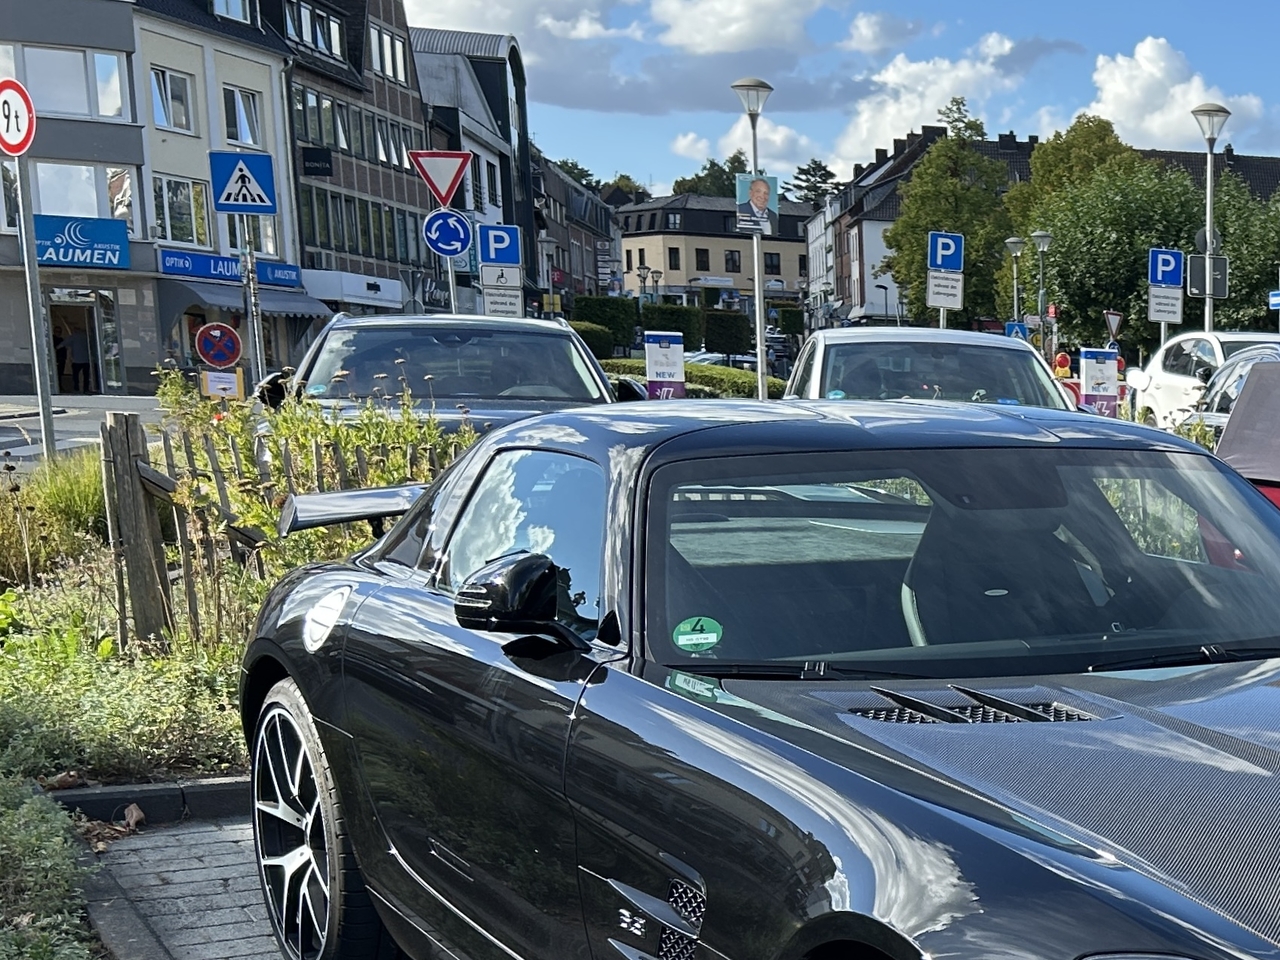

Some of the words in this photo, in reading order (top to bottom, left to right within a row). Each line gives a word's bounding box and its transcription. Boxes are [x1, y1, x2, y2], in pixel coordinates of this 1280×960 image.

[488, 230, 510, 259] P
[936, 237, 956, 265] P
[165, 256, 185, 268] OPTIK
[210, 259, 241, 276] LAUM
[1157, 254, 1176, 280] P
[691, 618, 706, 634] 4
